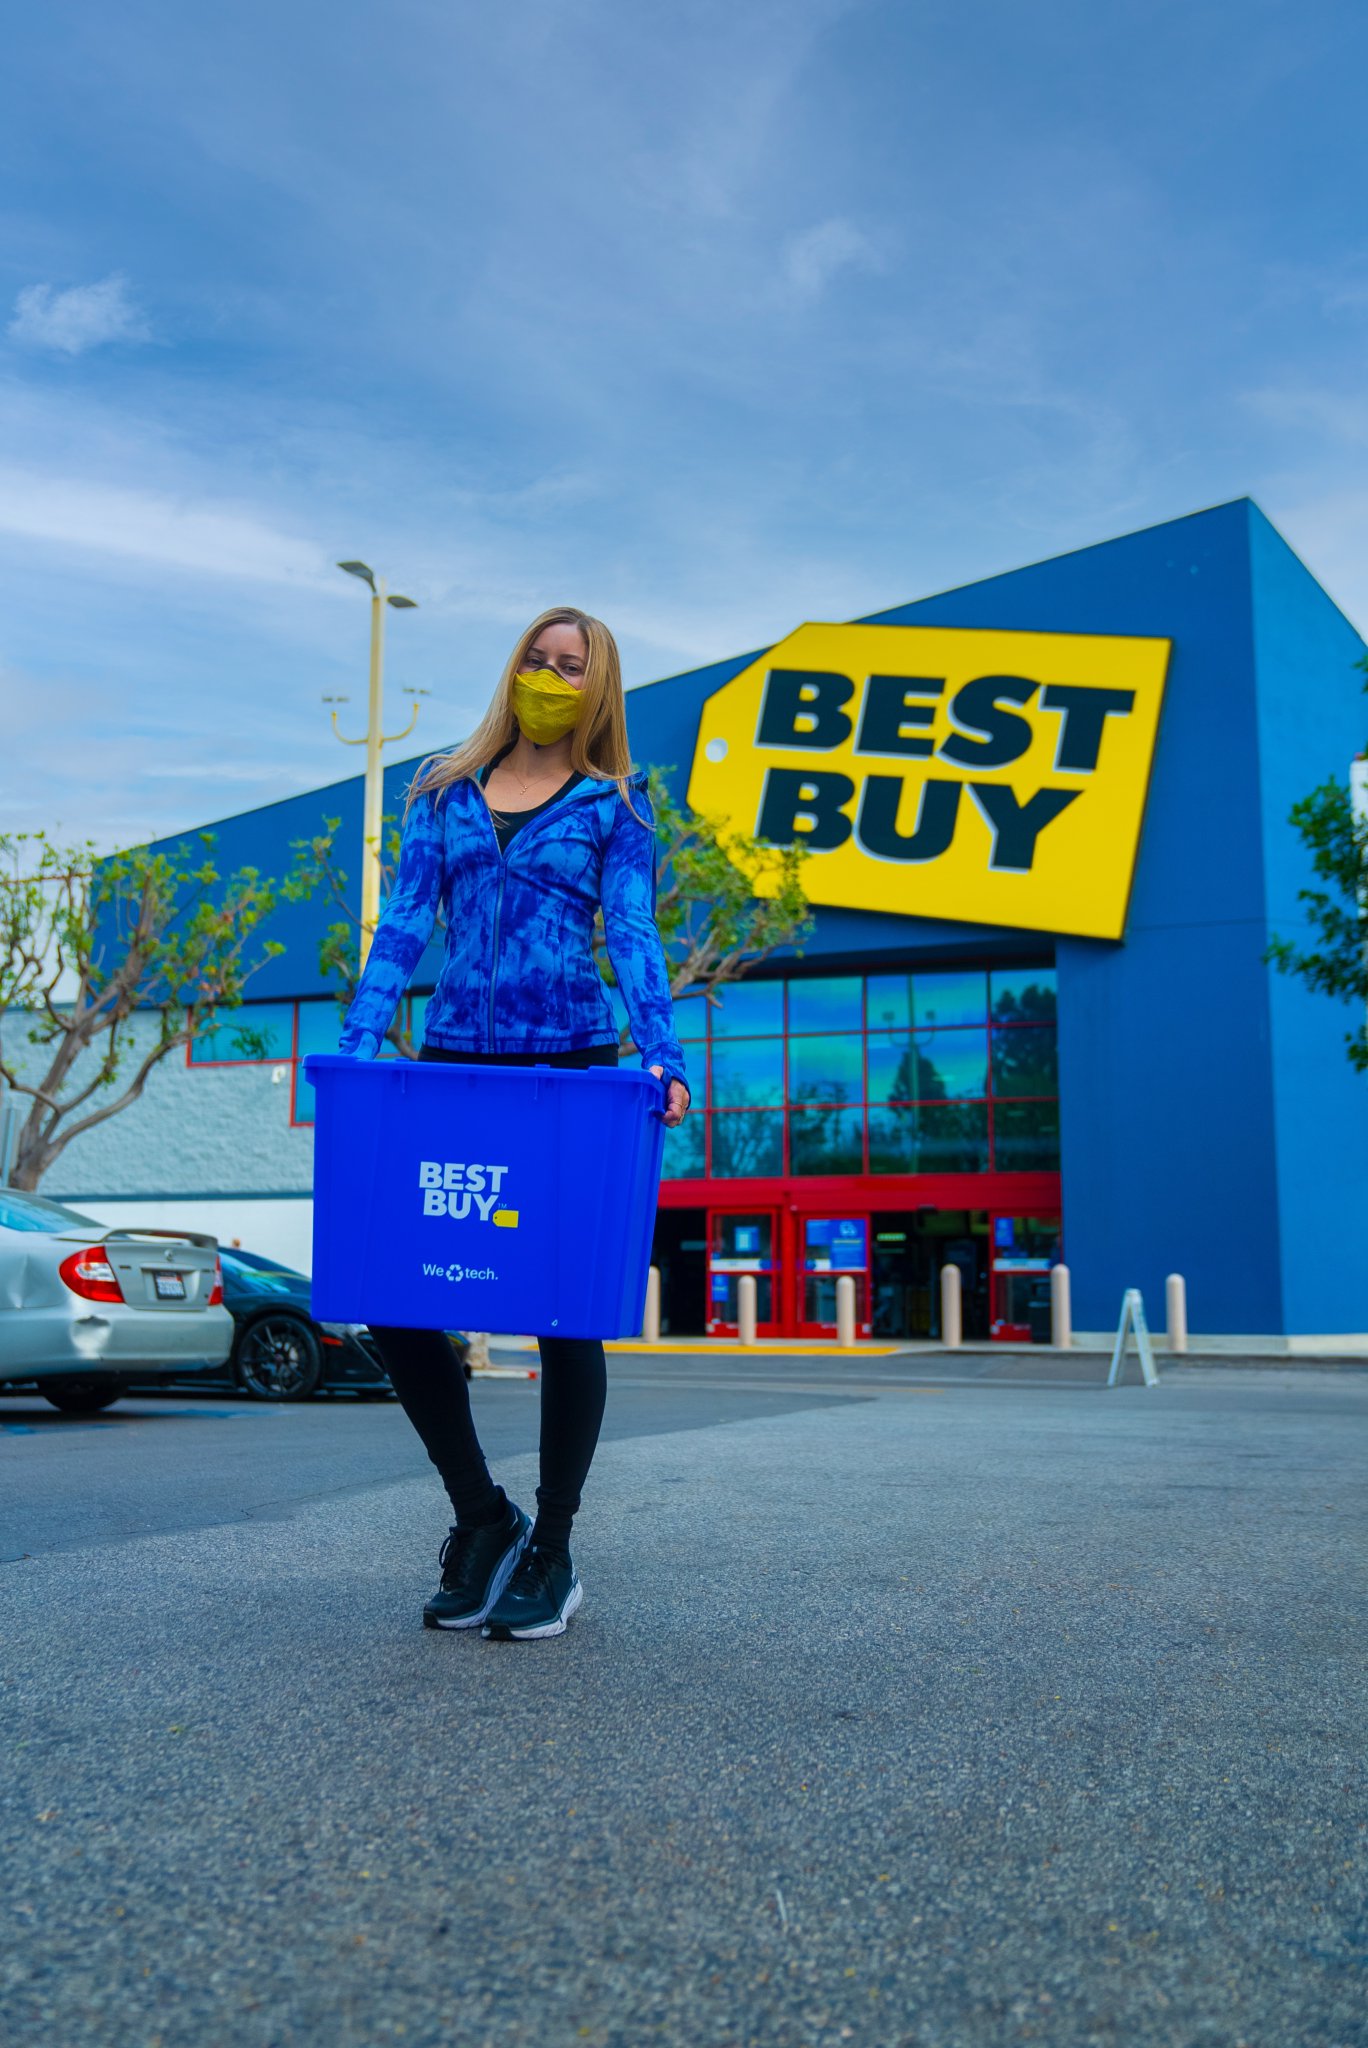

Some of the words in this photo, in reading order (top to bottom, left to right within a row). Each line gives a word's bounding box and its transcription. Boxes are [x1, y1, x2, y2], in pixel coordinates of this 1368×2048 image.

[755, 669, 1136, 773] BEST
[756, 767, 1085, 873] BUY
[419, 1161, 508, 1192] BEST
[423, 1189, 499, 1221] BUY
[423, 1263, 444, 1276] We
[465, 1267, 499, 1280] tech.
